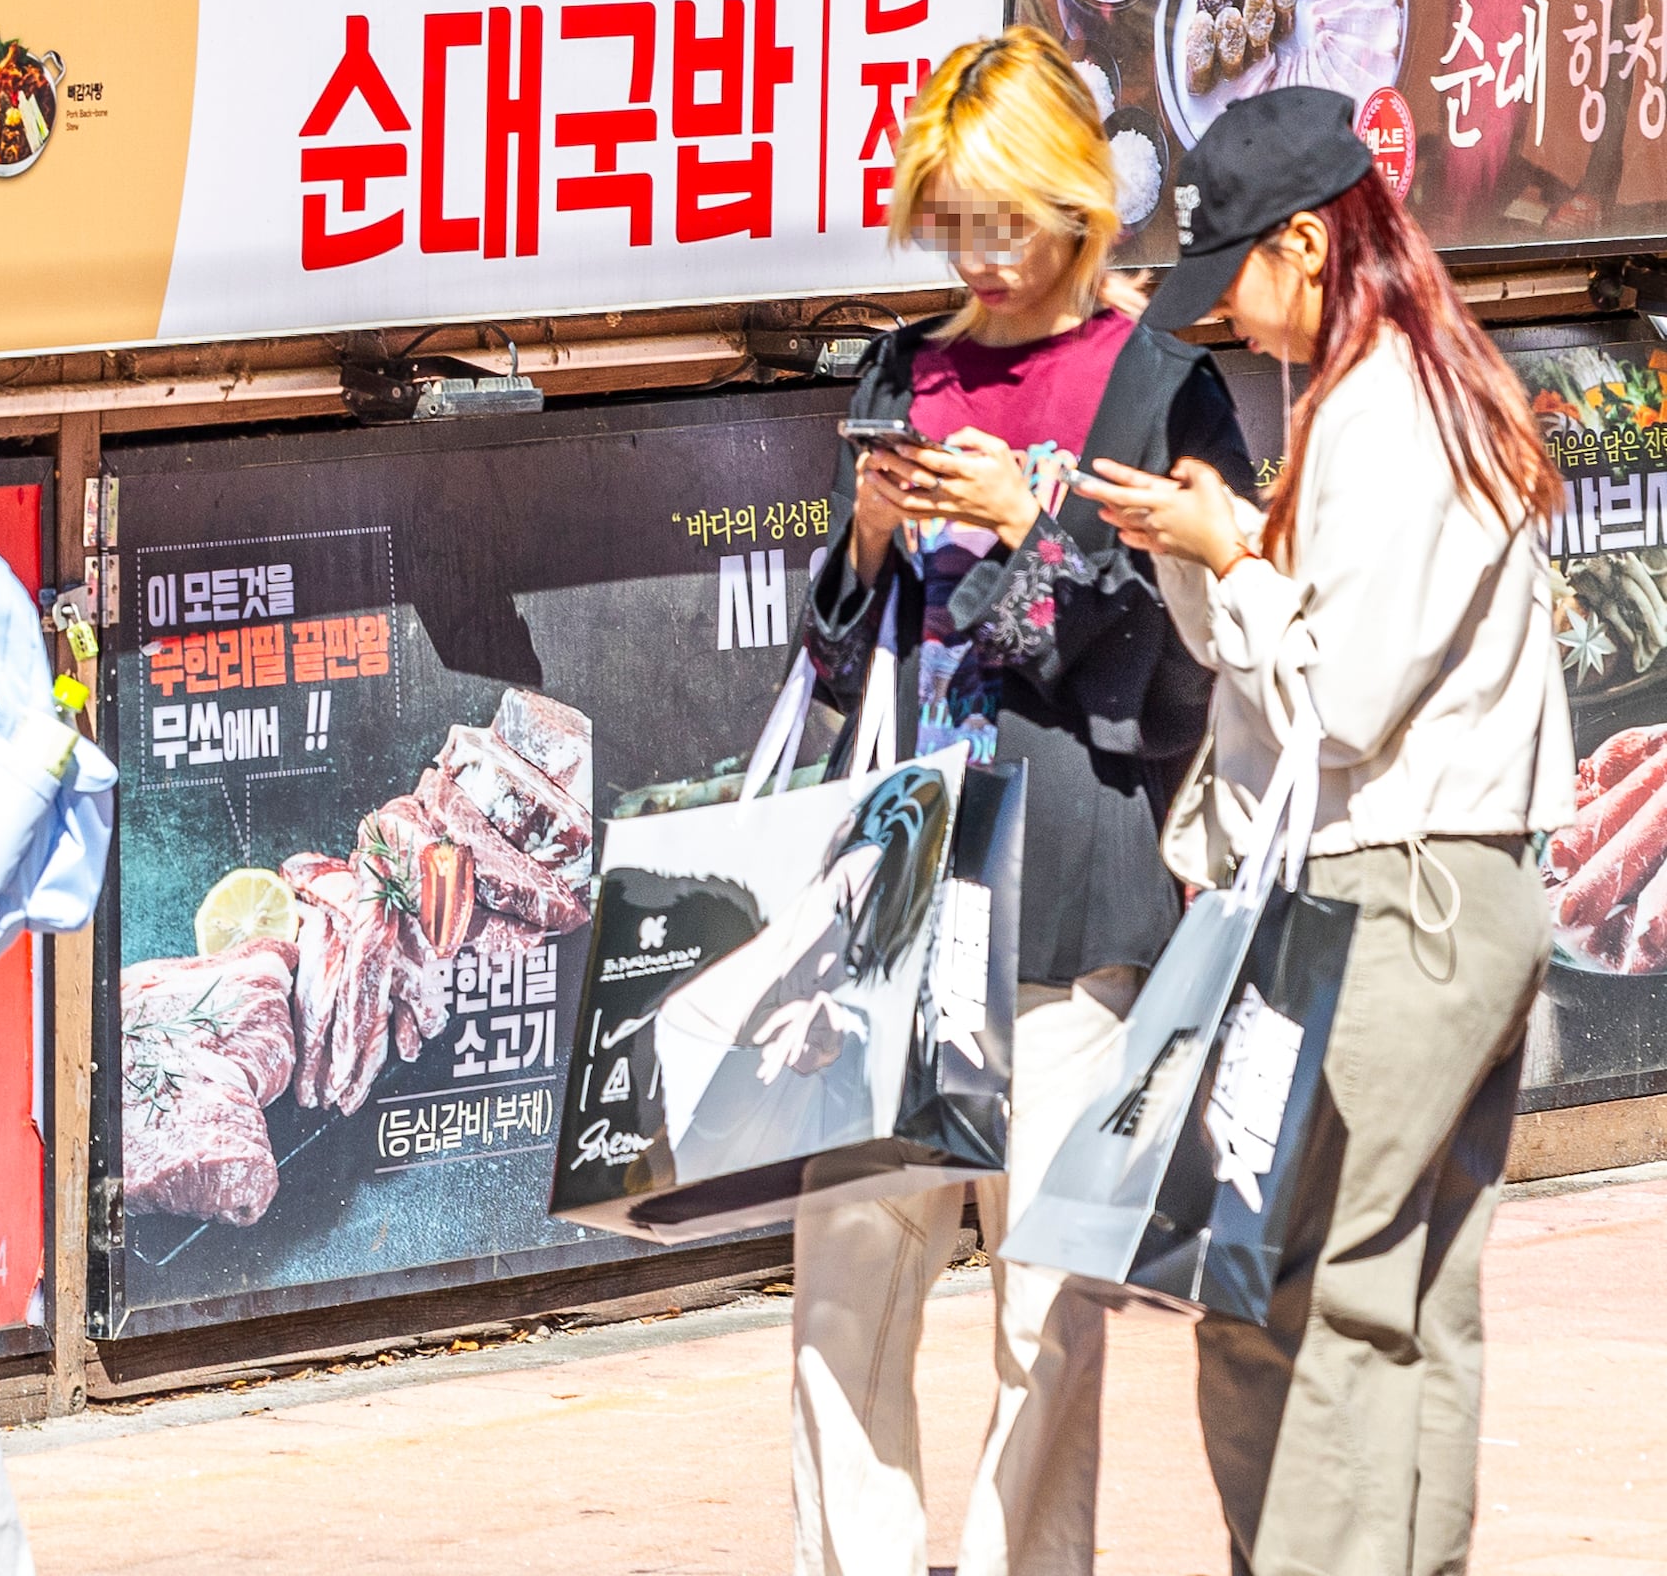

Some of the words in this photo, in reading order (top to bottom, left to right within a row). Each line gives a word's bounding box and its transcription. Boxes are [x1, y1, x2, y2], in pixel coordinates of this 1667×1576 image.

[1545, 432, 1600, 469] 마음을
[1603, 429, 1640, 464] 담은
[685, 504, 757, 547] 바다의
[763, 497, 832, 541] 싱싱함
[147, 574, 177, 628] 이
[183, 562, 295, 624] 모든것을
[150, 622, 287, 697] 무한리필
[291, 613, 391, 683] 끝판왕
[152, 700, 280, 770] 무쏘에서
[421, 942, 558, 1016] 무한리필
[452, 1008, 556, 1078] 소고기
